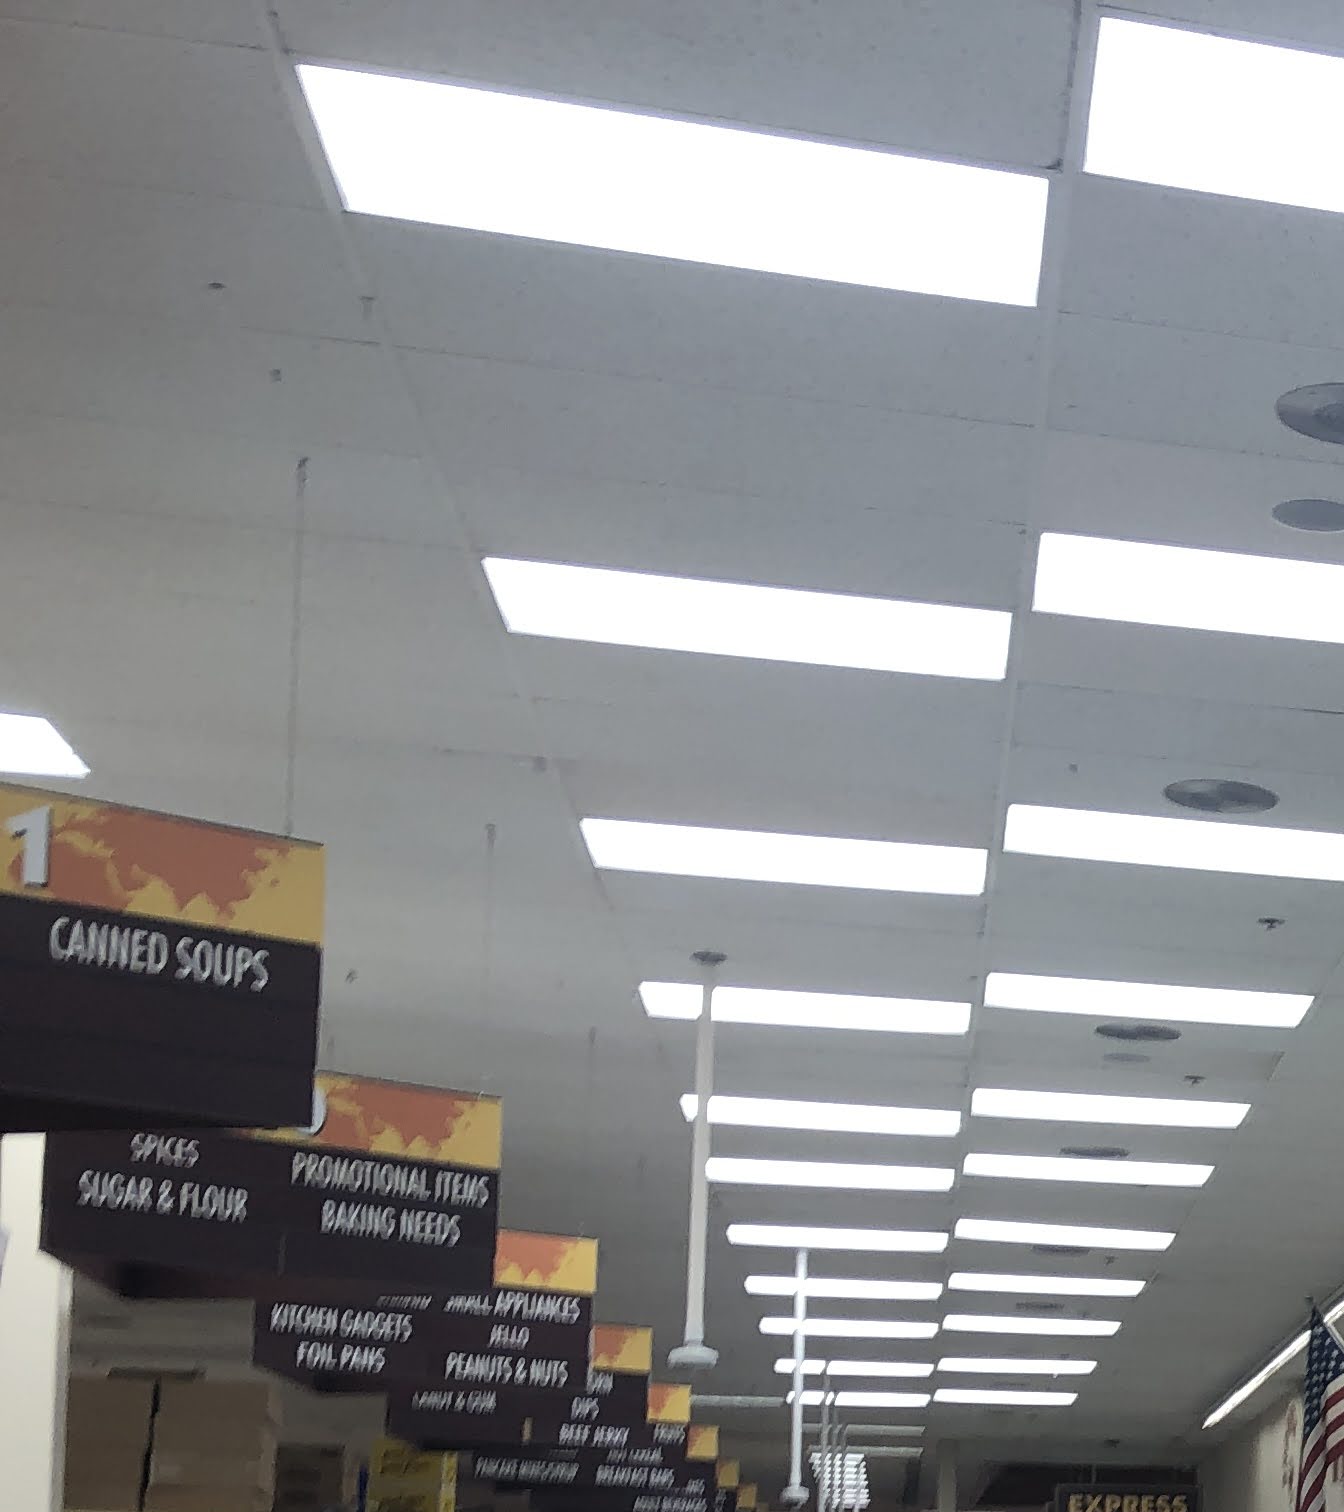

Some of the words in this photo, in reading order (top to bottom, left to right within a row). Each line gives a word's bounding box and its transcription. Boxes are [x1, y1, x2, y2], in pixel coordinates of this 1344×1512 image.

[5, 803, 52, 888] 1
[49, 915, 170, 976] CANNED
[174, 935, 271, 993] SOUPS
[128, 1132, 201, 1169] SPICES
[76, 1168, 154, 1214] SUGAR
[156, 1183, 175, 1216] &
[178, 1184, 249, 1224] FLOUR
[289, 1151, 433, 1202] PROMOTIONAL
[433, 1170, 490, 1209] ITEMS
[319, 1198, 397, 1241] BAKING
[399, 1211, 462, 1249] NEEDS
[268, 1302, 340, 1339] KITCHEN
[339, 1308, 413, 1344] GADGETS
[493, 1289, 582, 1325] APPLIANCES
[295, 1339, 338, 1371] FOIL
[340, 1343, 386, 1374] PANS
[444, 1350, 514, 1386] PEANUTS
[513, 1355, 529, 1386] &
[528, 1358, 569, 1389] NUTS
